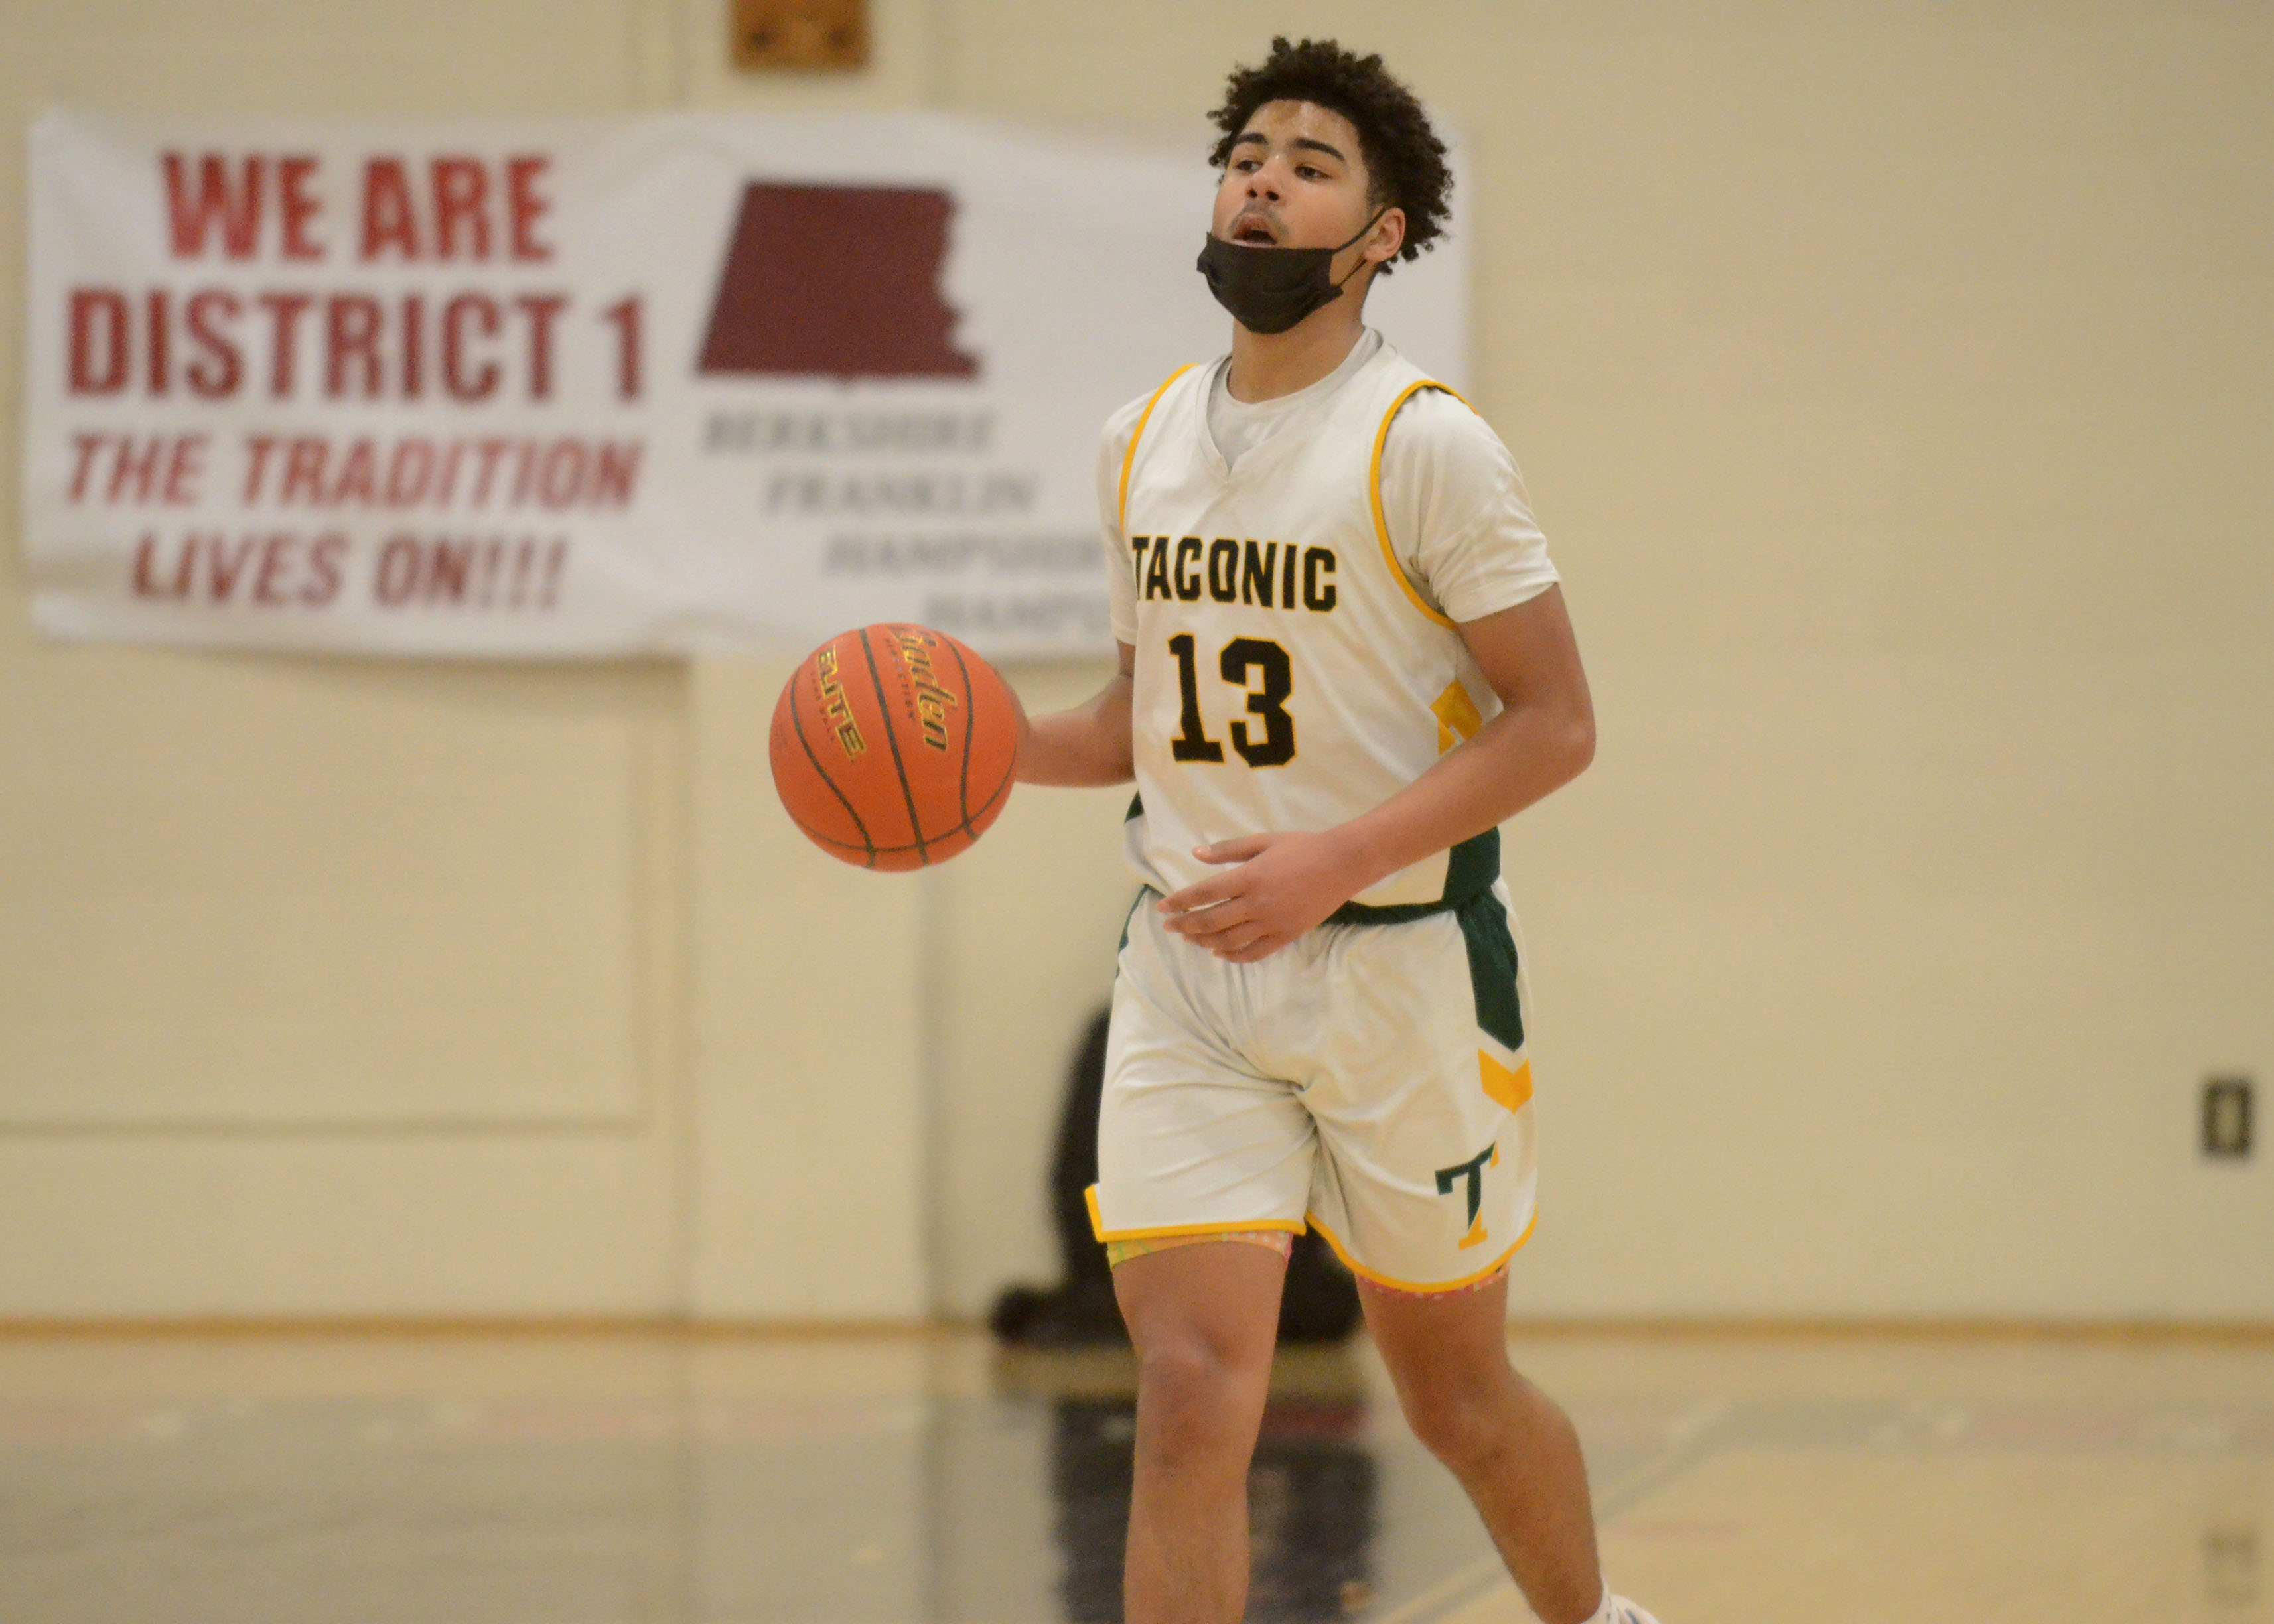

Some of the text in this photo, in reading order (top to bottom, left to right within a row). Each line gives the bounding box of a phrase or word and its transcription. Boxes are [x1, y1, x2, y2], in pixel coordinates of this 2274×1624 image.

[160, 150, 555, 261] WE ARE
[68, 287, 644, 403] DISTRICT 1
[68, 431, 644, 512] THE TRADITION
[131, 533, 567, 610] LIVES ON!!!
[1132, 535, 1336, 613] TACONIC
[817, 645, 866, 760] ELITE
[1167, 632, 1297, 769] 13
